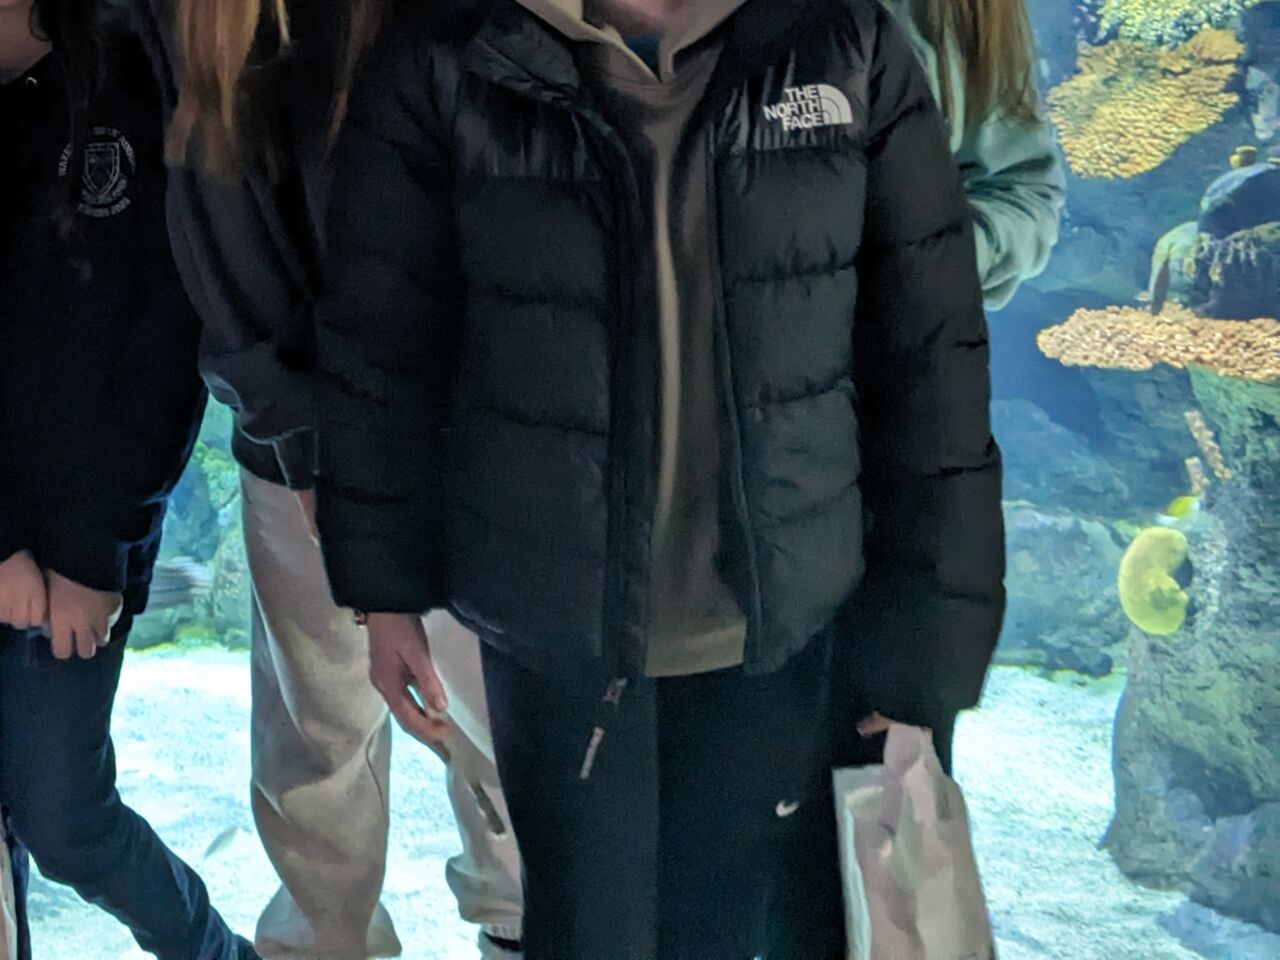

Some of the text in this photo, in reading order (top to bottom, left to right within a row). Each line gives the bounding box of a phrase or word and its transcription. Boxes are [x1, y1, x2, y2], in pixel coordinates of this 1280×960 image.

[784, 84, 818, 101] THE
[763, 98, 821, 121] NORTH
[782, 112, 824, 131] FACE
